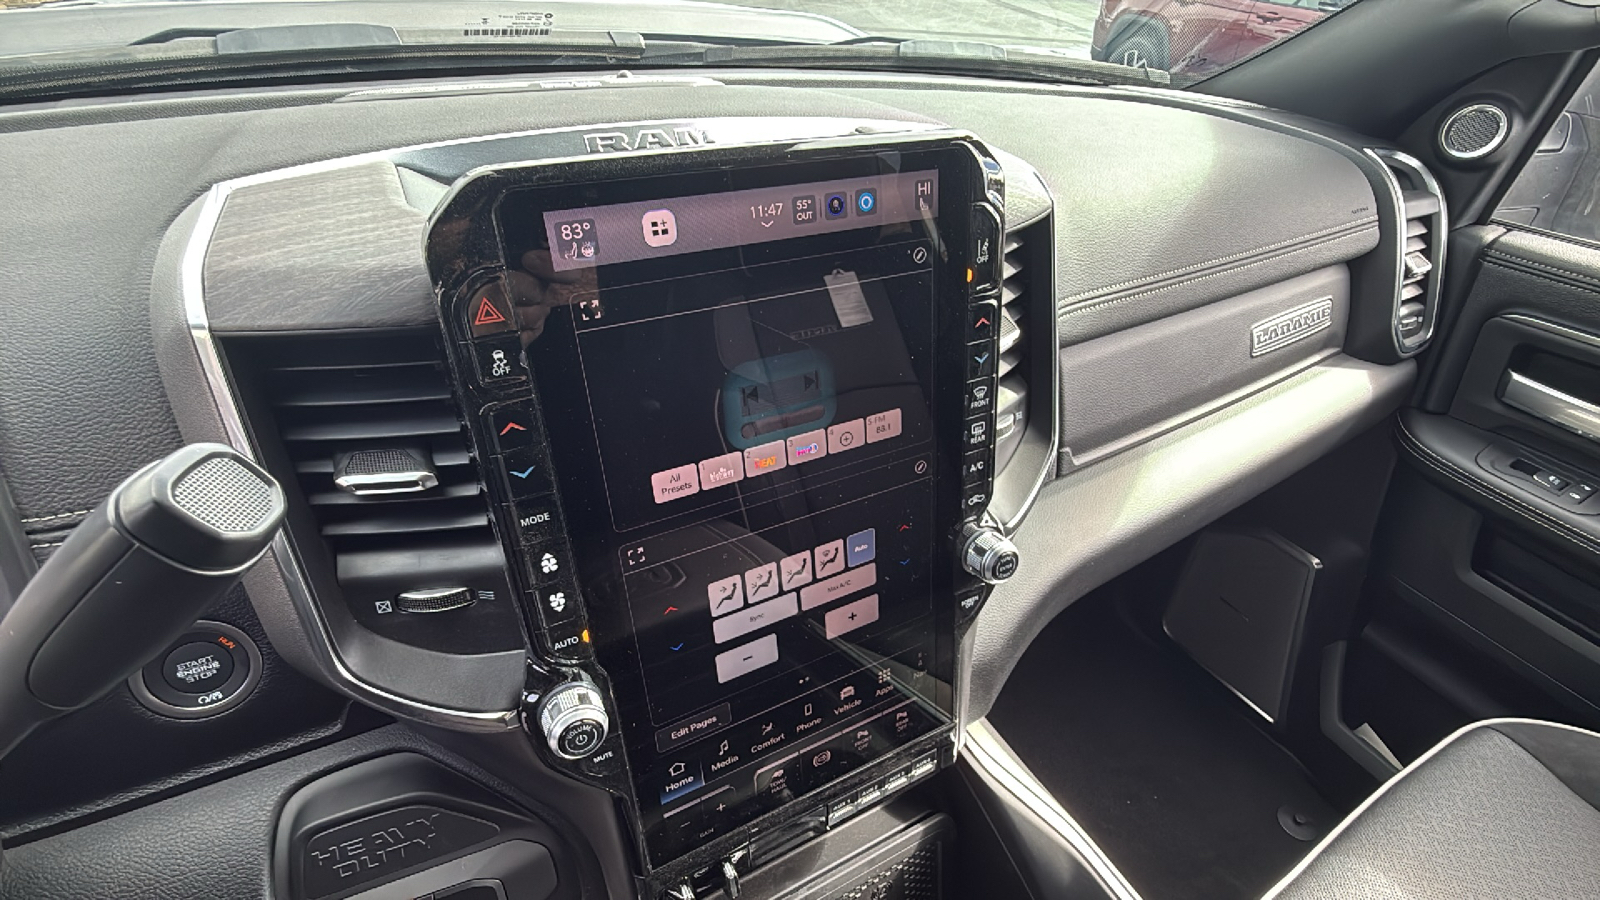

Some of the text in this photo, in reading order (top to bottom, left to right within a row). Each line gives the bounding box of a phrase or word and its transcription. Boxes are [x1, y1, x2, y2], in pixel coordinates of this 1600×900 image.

[583, 127, 717, 153] RAM
[918, 181, 931, 195] HI
[750, 202, 784, 219] 11:47
[796, 210, 813, 221] OUT
[561, 222, 591, 241] 83°
[1255, 306, 1331, 345] LARAMIE
[492, 365, 511, 377] OFF
[970, 398, 989, 409] FRONT
[970, 434, 986, 444] REAR
[970, 461, 984, 473] A/C
[670, 473, 681, 483] All
[661, 481, 692, 495] Presets
[520, 512, 551, 527] MODE
[218, 636, 236, 649] RUN
[554, 636, 579, 650] AUTO
[176, 654, 214, 671] START
[176, 661, 221, 679] ENGINE
[185, 669, 218, 684] STOP
[875, 685, 894, 697] Apps
[834, 698, 862, 716] Vehicle
[566, 724, 593, 740] VOLUME
[671, 715, 718, 740] Edit Pages
[796, 718, 822, 733] Phone
[751, 733, 786, 754] Comfort
[593, 750, 614, 764] MUTE
[711, 755, 739, 772] Media
[665, 775, 694, 793] Home
[311, 812, 441, 866] HEAVY
[333, 832, 437, 878] DUTY
